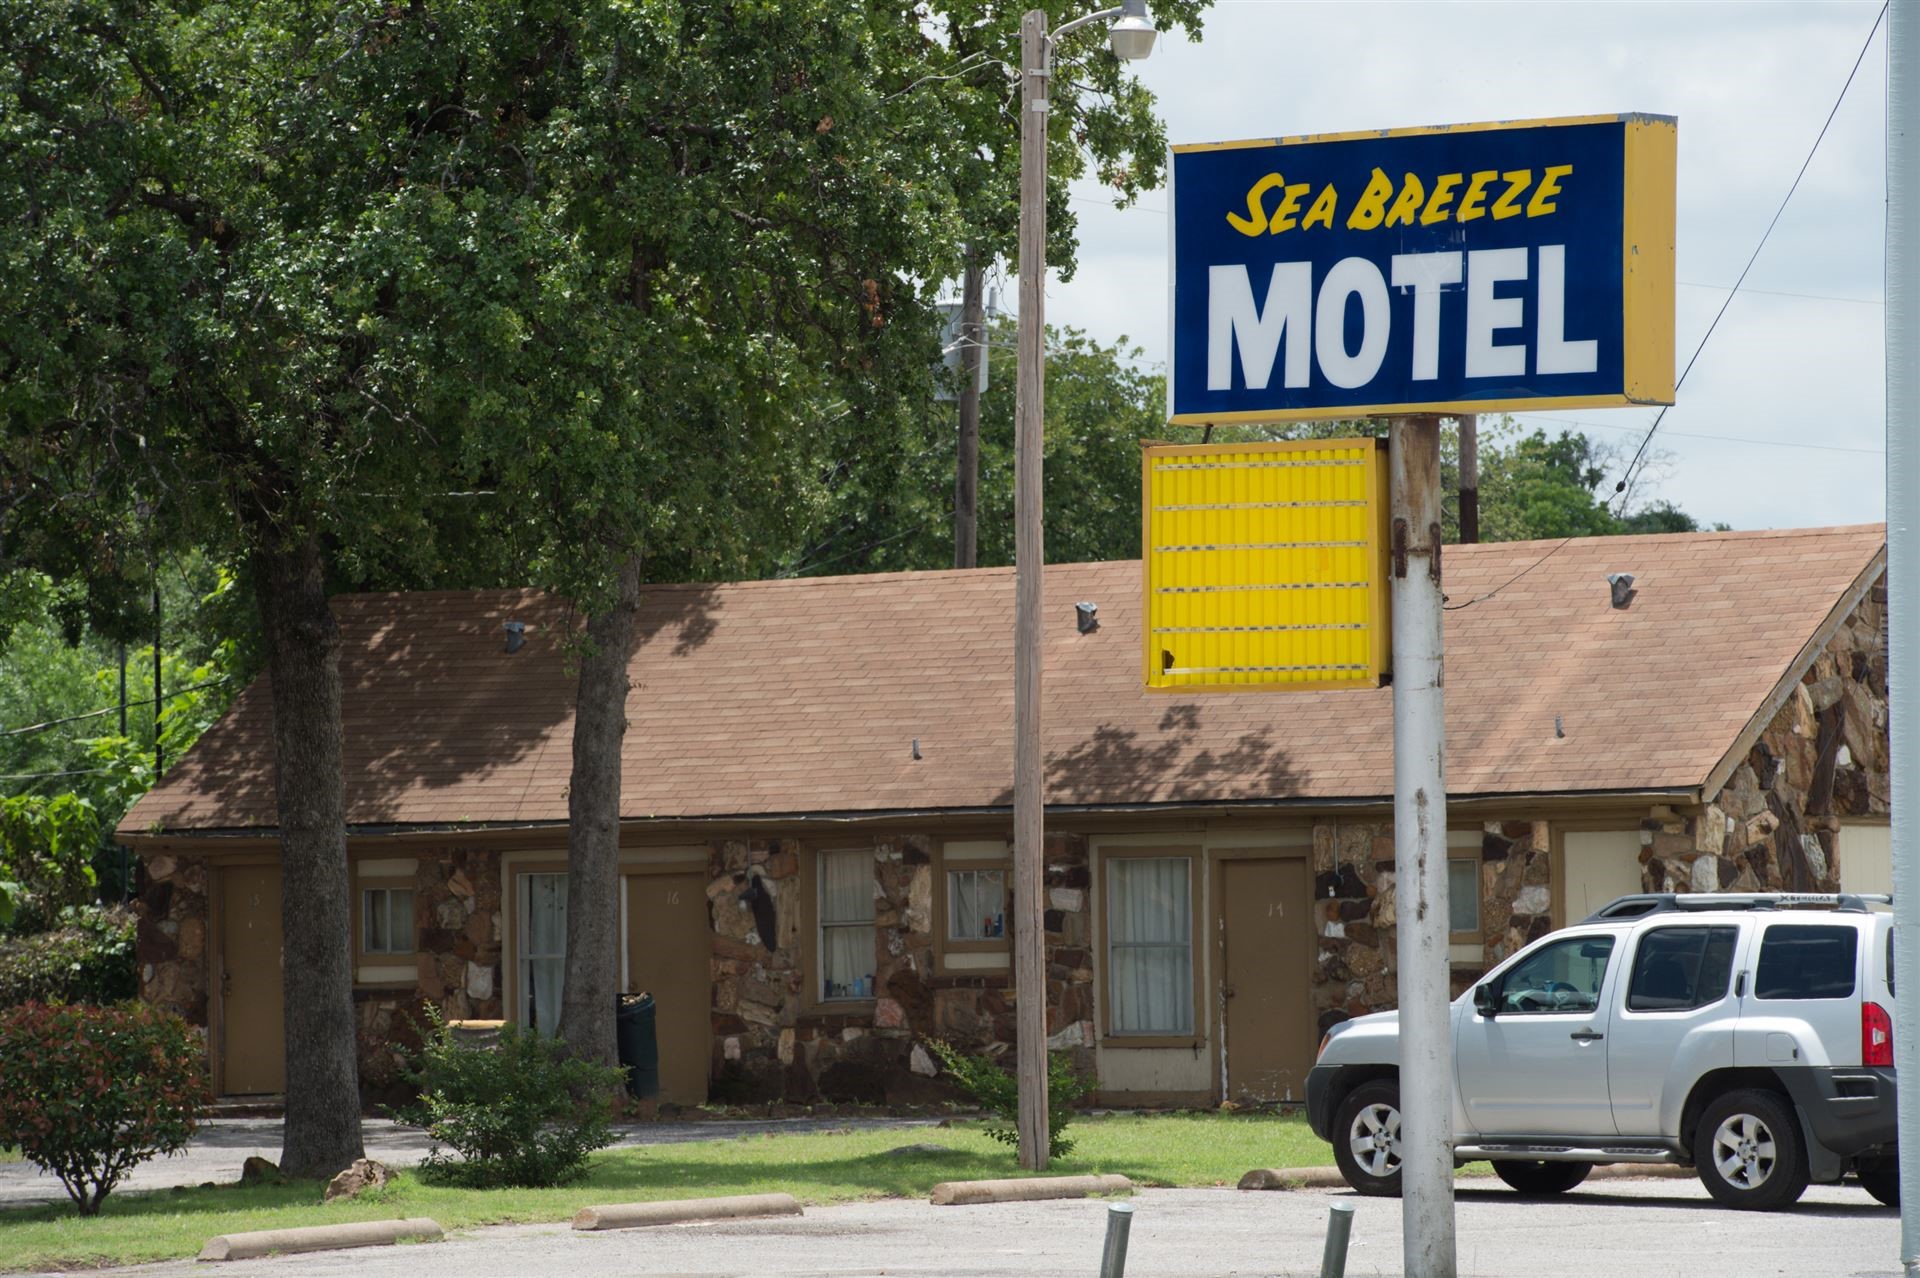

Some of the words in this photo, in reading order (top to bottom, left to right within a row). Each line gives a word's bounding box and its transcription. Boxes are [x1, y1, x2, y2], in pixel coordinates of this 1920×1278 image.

[1226, 172, 1338, 237] SEA
[1346, 164, 1573, 231] BREEZE
[1207, 244, 1598, 391] MOTEL
[666, 890, 680, 905] 16
